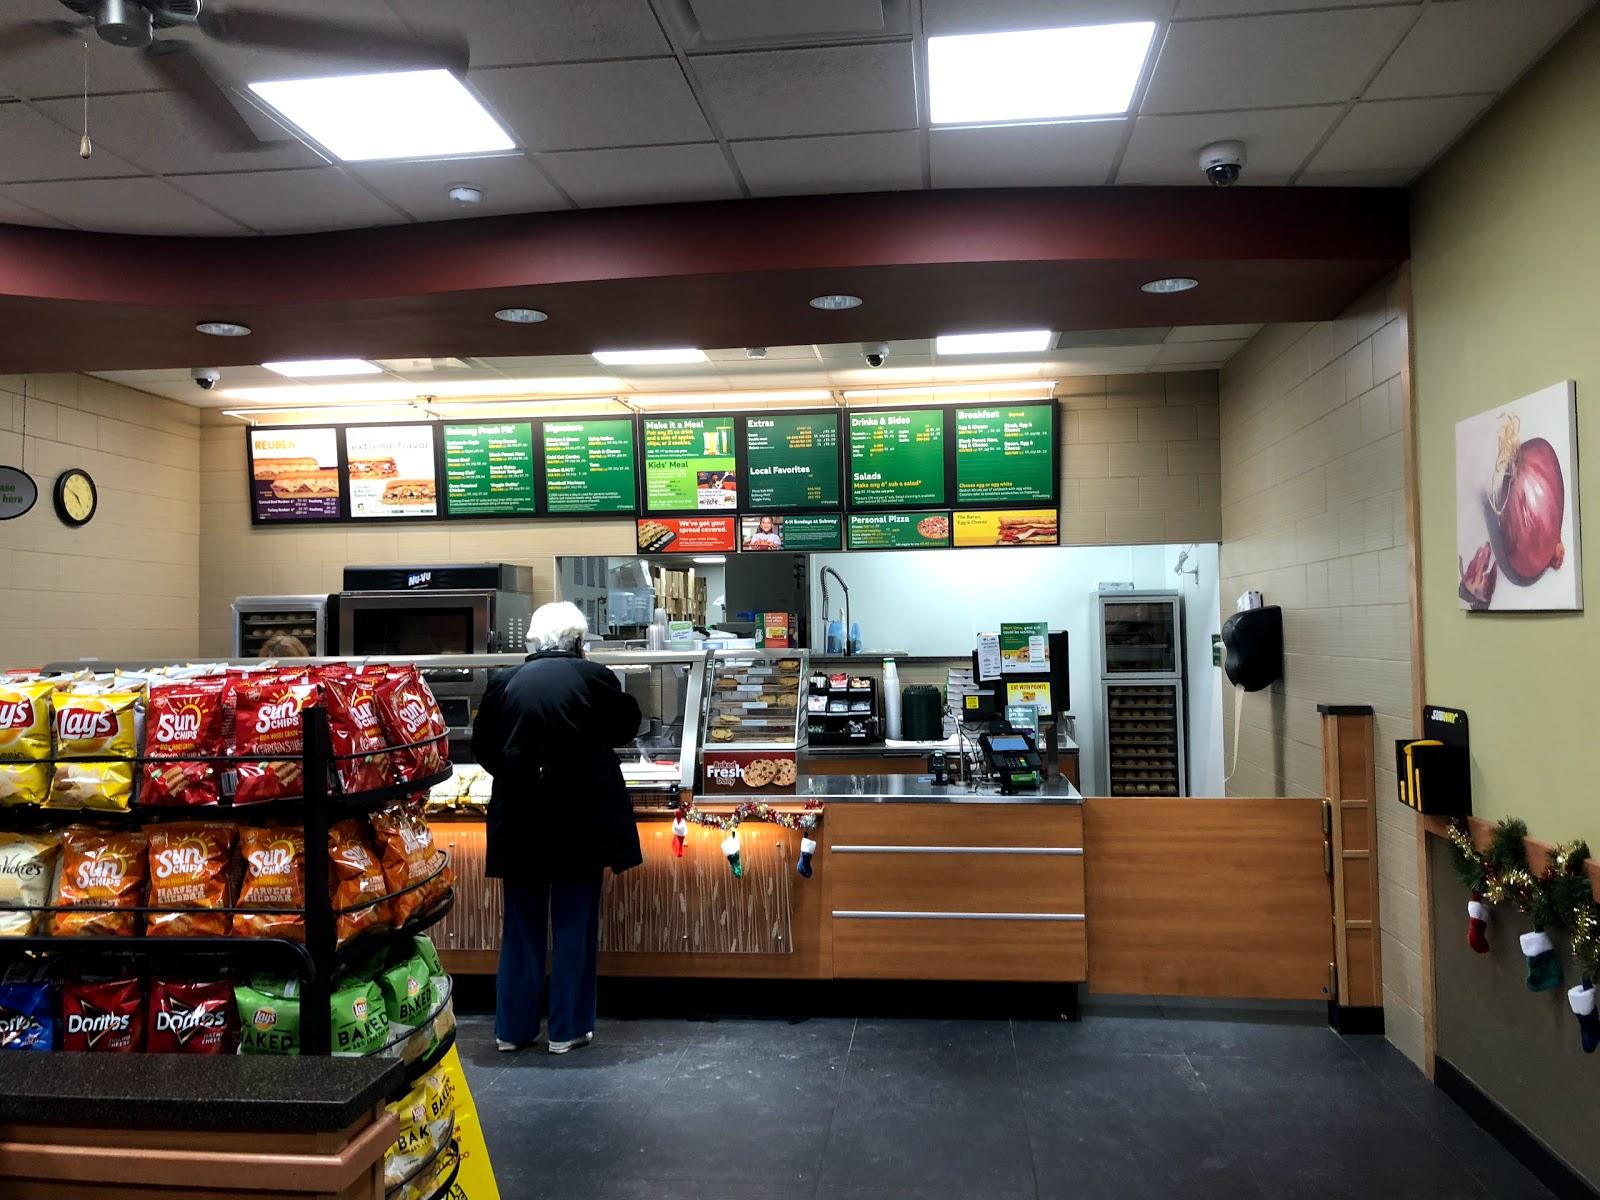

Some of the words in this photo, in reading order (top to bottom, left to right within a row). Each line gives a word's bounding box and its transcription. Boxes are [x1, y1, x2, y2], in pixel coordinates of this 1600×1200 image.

[646, 421, 668, 430] Make
[669, 421, 677, 429] it
[684, 420, 705, 429] Meal
[748, 419, 775, 428] Extras
[852, 418, 878, 427] Drinks
[879, 417, 887, 426] &
[888, 416, 911, 425] Sides
[255, 440, 295, 450] REUBEN
[648, 461, 667, 469] Kids'
[669, 461, 688, 469] Meal
[750, 466, 771, 475] Local
[773, 465, 811, 474] Favorites
[853, 472, 882, 481] Salads
[3, 493, 24, 504] here
[851, 516, 887, 524] Personal
[888, 515, 910, 523] Pizza
[679, 526, 701, 534] spread
[255, 700, 300, 735] Sun
[270, 714, 300, 730] CHIPS
[156, 711, 200, 743] Sun
[174, 728, 199, 741] CHIPS
[706, 764, 746, 778] Fresh
[716, 777, 736, 787] Daily
[156, 847, 202, 879] Sun
[249, 848, 292, 878] Sun
[76, 860, 121, 889] Sun
[88, 877, 121, 887] CHIPS
[157, 883, 206, 897] HARVEST
[157, 892, 206, 904] CHEDDAR
[244, 894, 293, 902] CHEDDAR
[400, 988, 431, 1019] BAKED
[68, 1014, 130, 1033] Doritos
[156, 1010, 226, 1034] Doritos
[337, 1011, 389, 1048] BAKED
